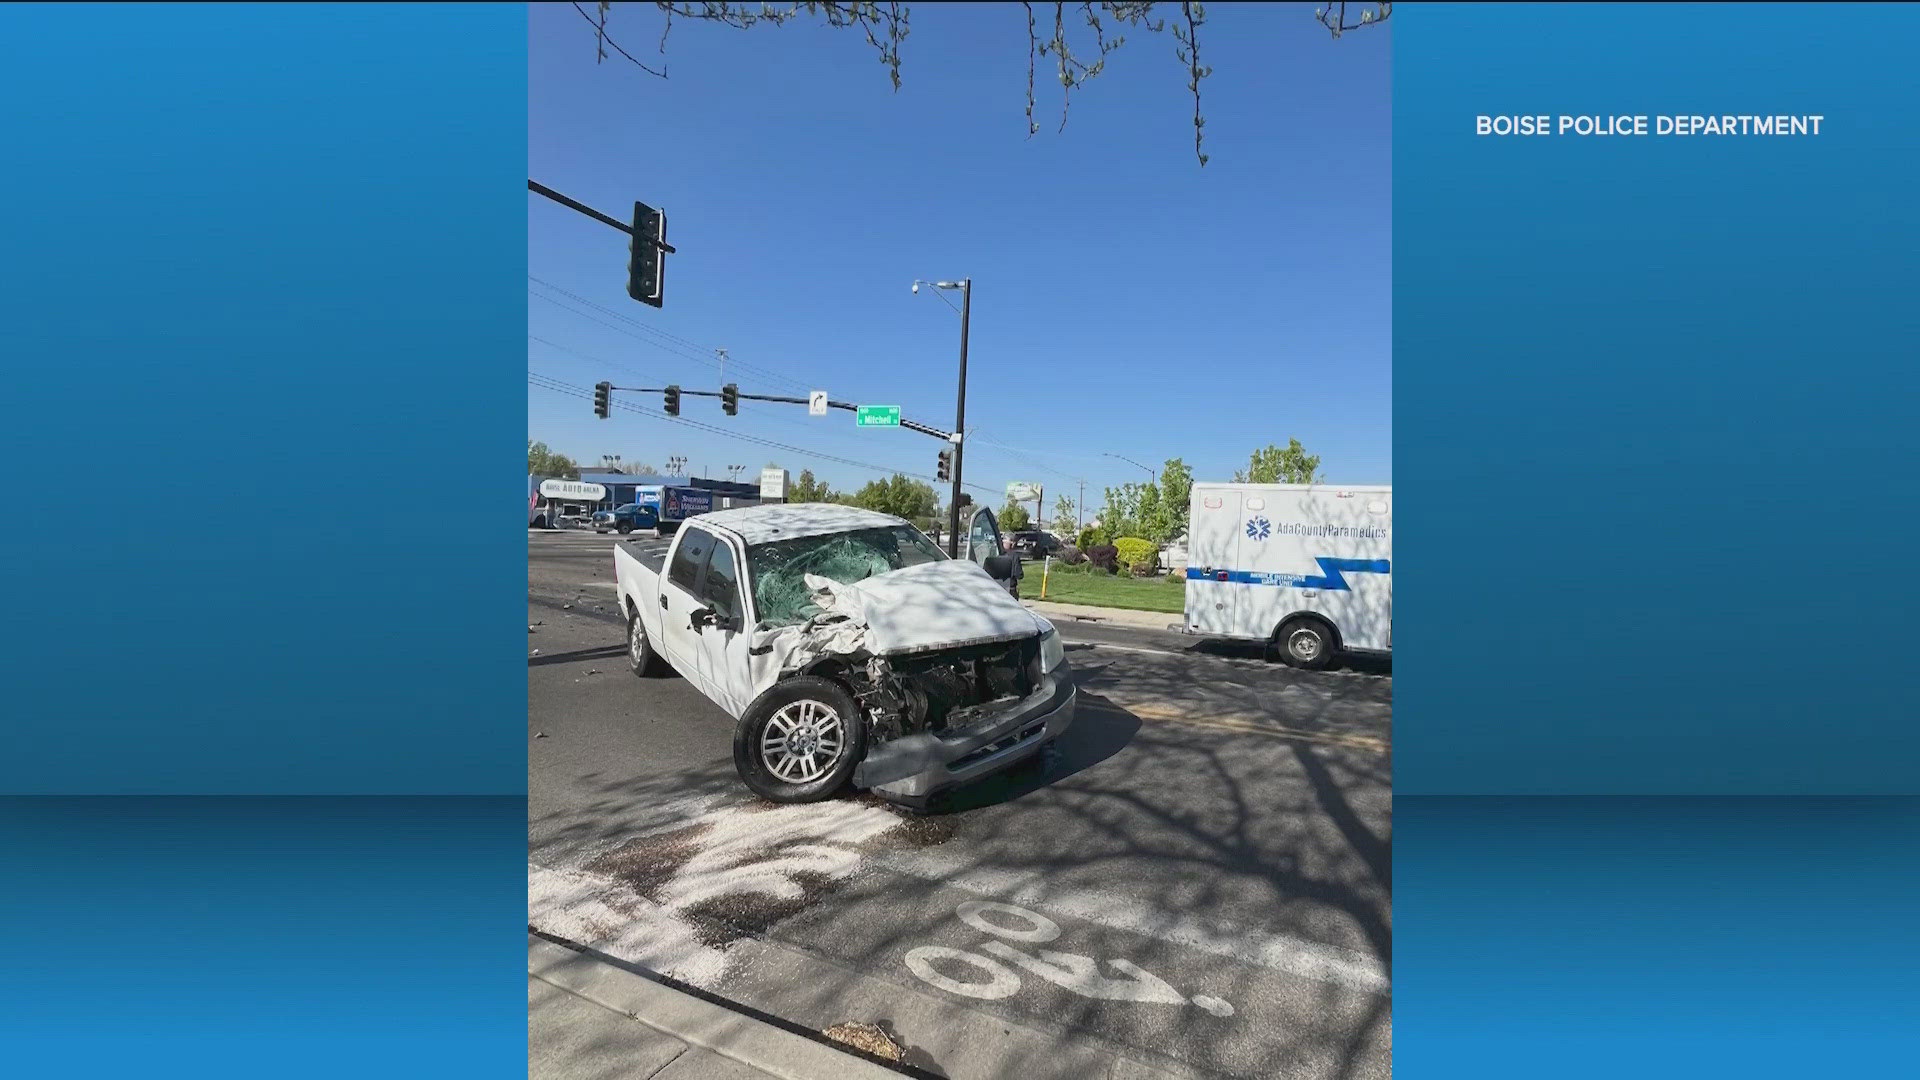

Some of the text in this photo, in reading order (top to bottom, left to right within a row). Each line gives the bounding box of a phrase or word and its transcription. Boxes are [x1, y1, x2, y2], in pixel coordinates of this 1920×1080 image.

[864, 415, 892, 425] Mitchell
[563, 483, 582, 493] AUTO
[1277, 522, 1387, 538] AdaCountyParamedics
[1274, 574, 1306, 582] INTENSIVE
